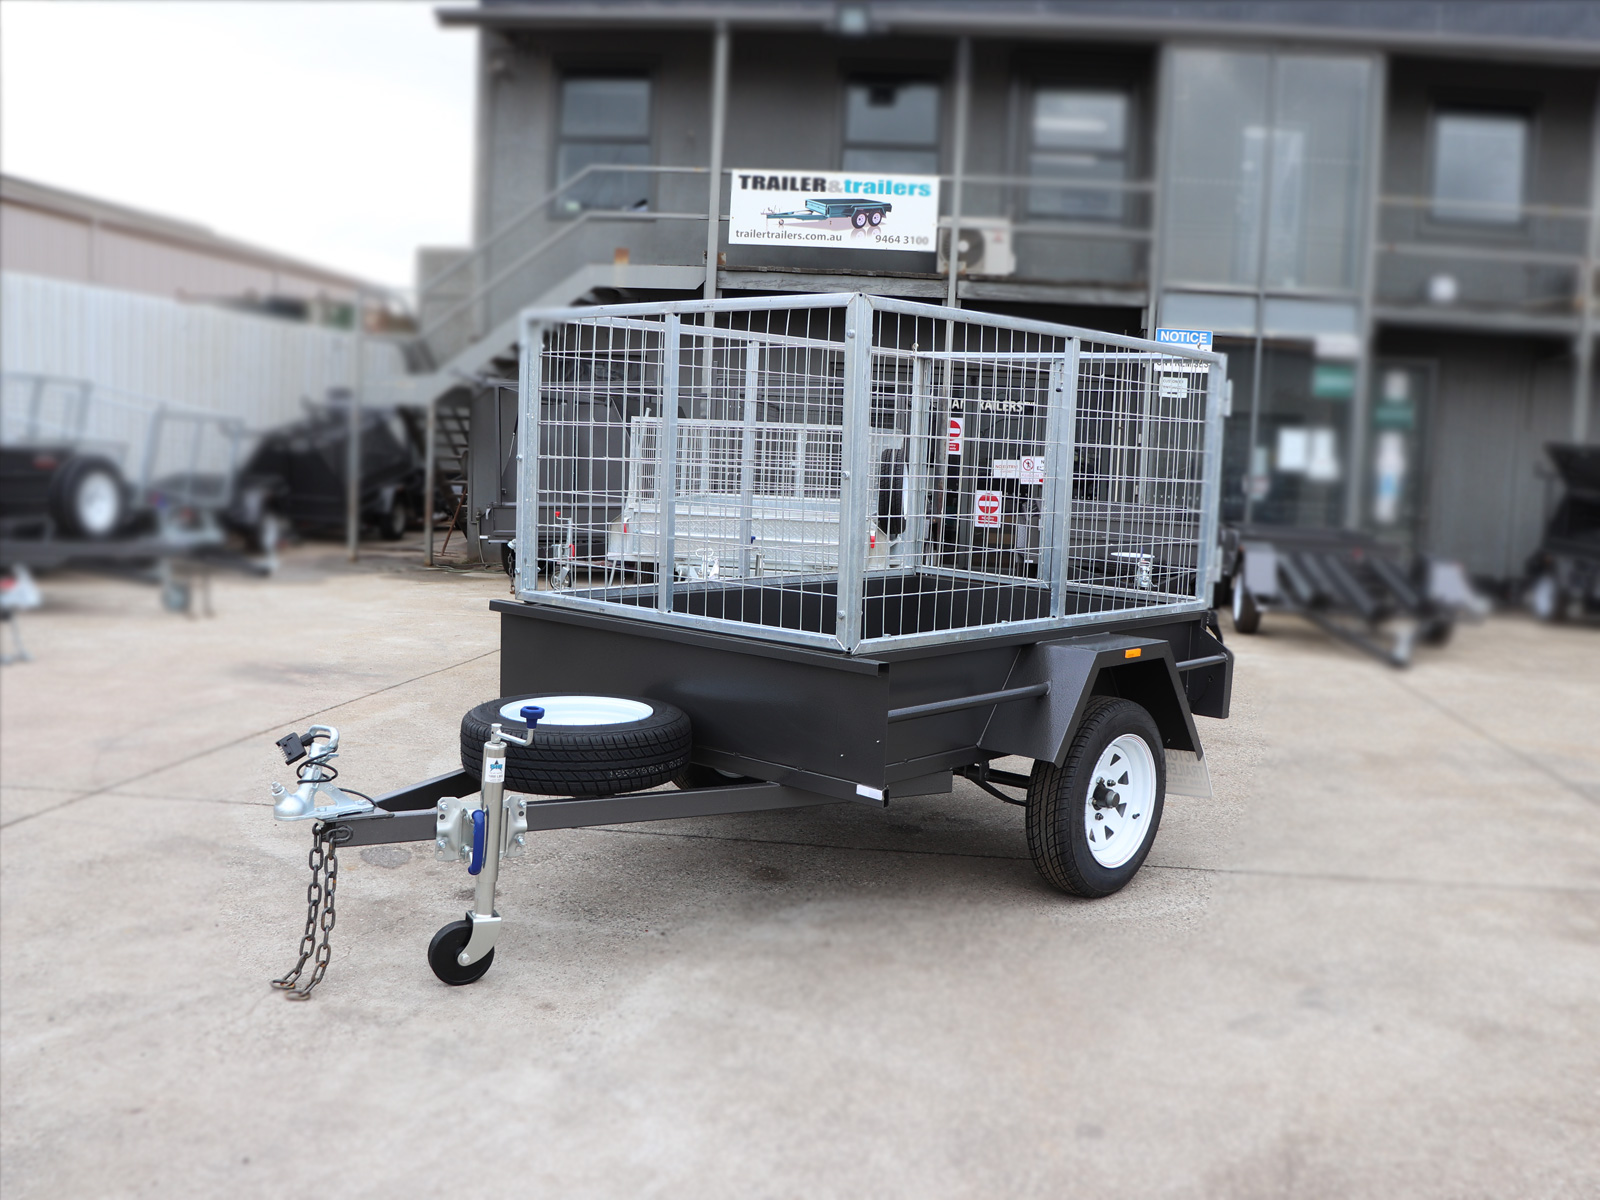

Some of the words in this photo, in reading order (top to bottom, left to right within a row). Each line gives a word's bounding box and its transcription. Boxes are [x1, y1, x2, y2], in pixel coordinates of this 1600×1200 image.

[735, 229, 843, 242] trailertrailers.com.au
[875, 234, 901, 245] 9464
[903, 235, 929, 246] 3100
[1160, 330, 1208, 344] NOTICE
